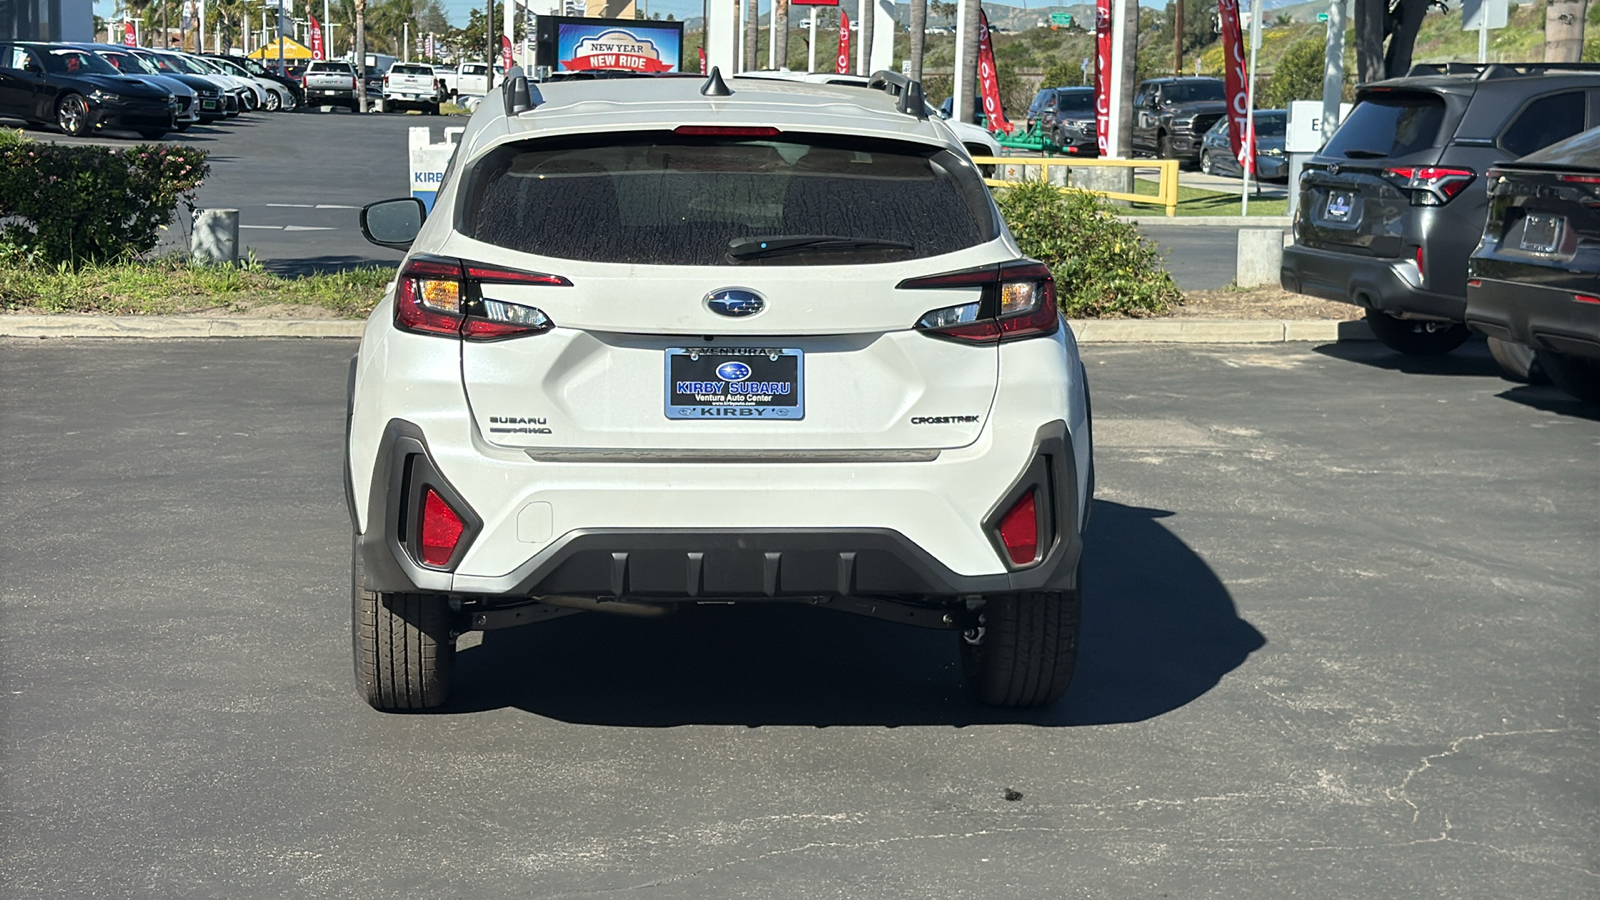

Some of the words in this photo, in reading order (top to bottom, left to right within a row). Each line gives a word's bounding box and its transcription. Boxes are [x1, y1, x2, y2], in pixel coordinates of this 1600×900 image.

[591, 43, 614, 53] NEW
[616, 44, 644, 53] YEAR
[589, 55, 617, 67] NEW
[619, 56, 647, 69] RIDE
[414, 172, 443, 183] KIRB
[677, 382, 725, 394] KIRBY
[729, 382, 791, 394] SUBARU
[701, 408, 767, 416] KIRBY
[489, 416, 547, 424] SUBARU
[911, 415, 979, 424] CROSSTREK
